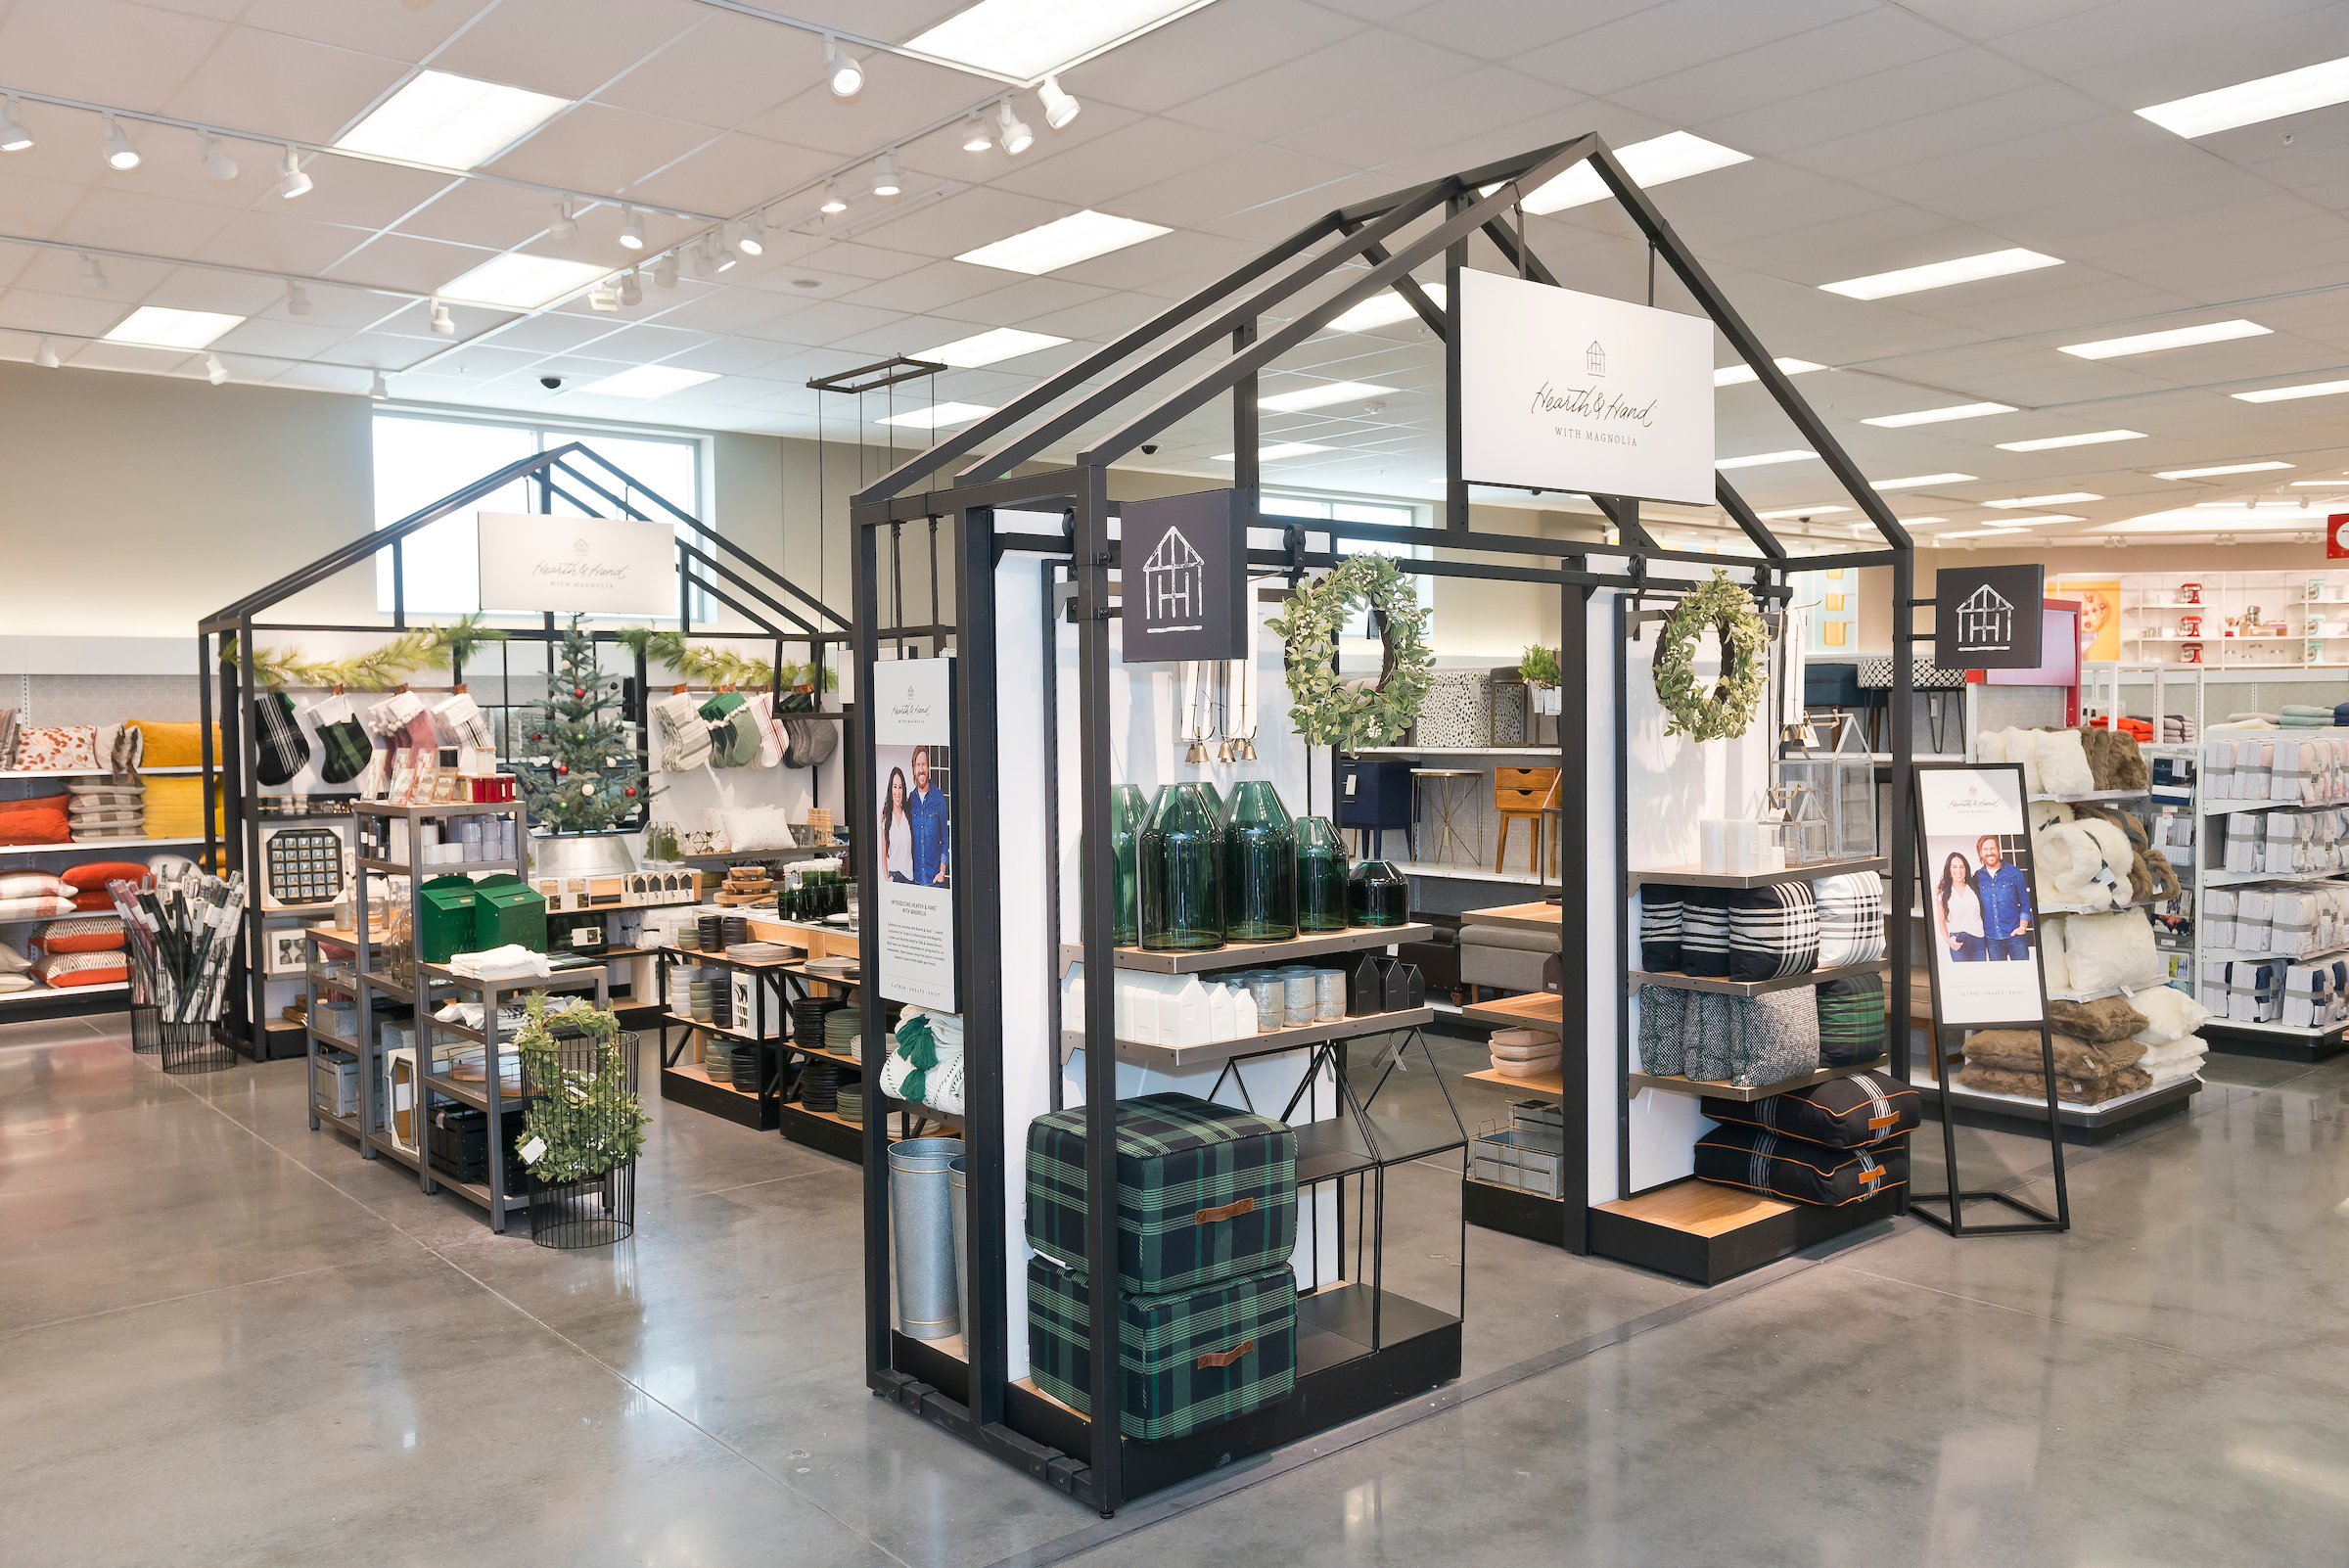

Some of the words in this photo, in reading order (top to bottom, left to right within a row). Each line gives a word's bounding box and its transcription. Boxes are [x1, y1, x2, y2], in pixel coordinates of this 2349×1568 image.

[1531, 381, 1596, 417] Hearth
[1593, 392, 1605, 420] &
[1604, 393, 1657, 428] Hand
[1554, 426, 1581, 438] WITH
[1586, 431, 1637, 446] MAGNOLIA
[531, 560, 582, 576] Hearth
[588, 562, 629, 579] Hand
